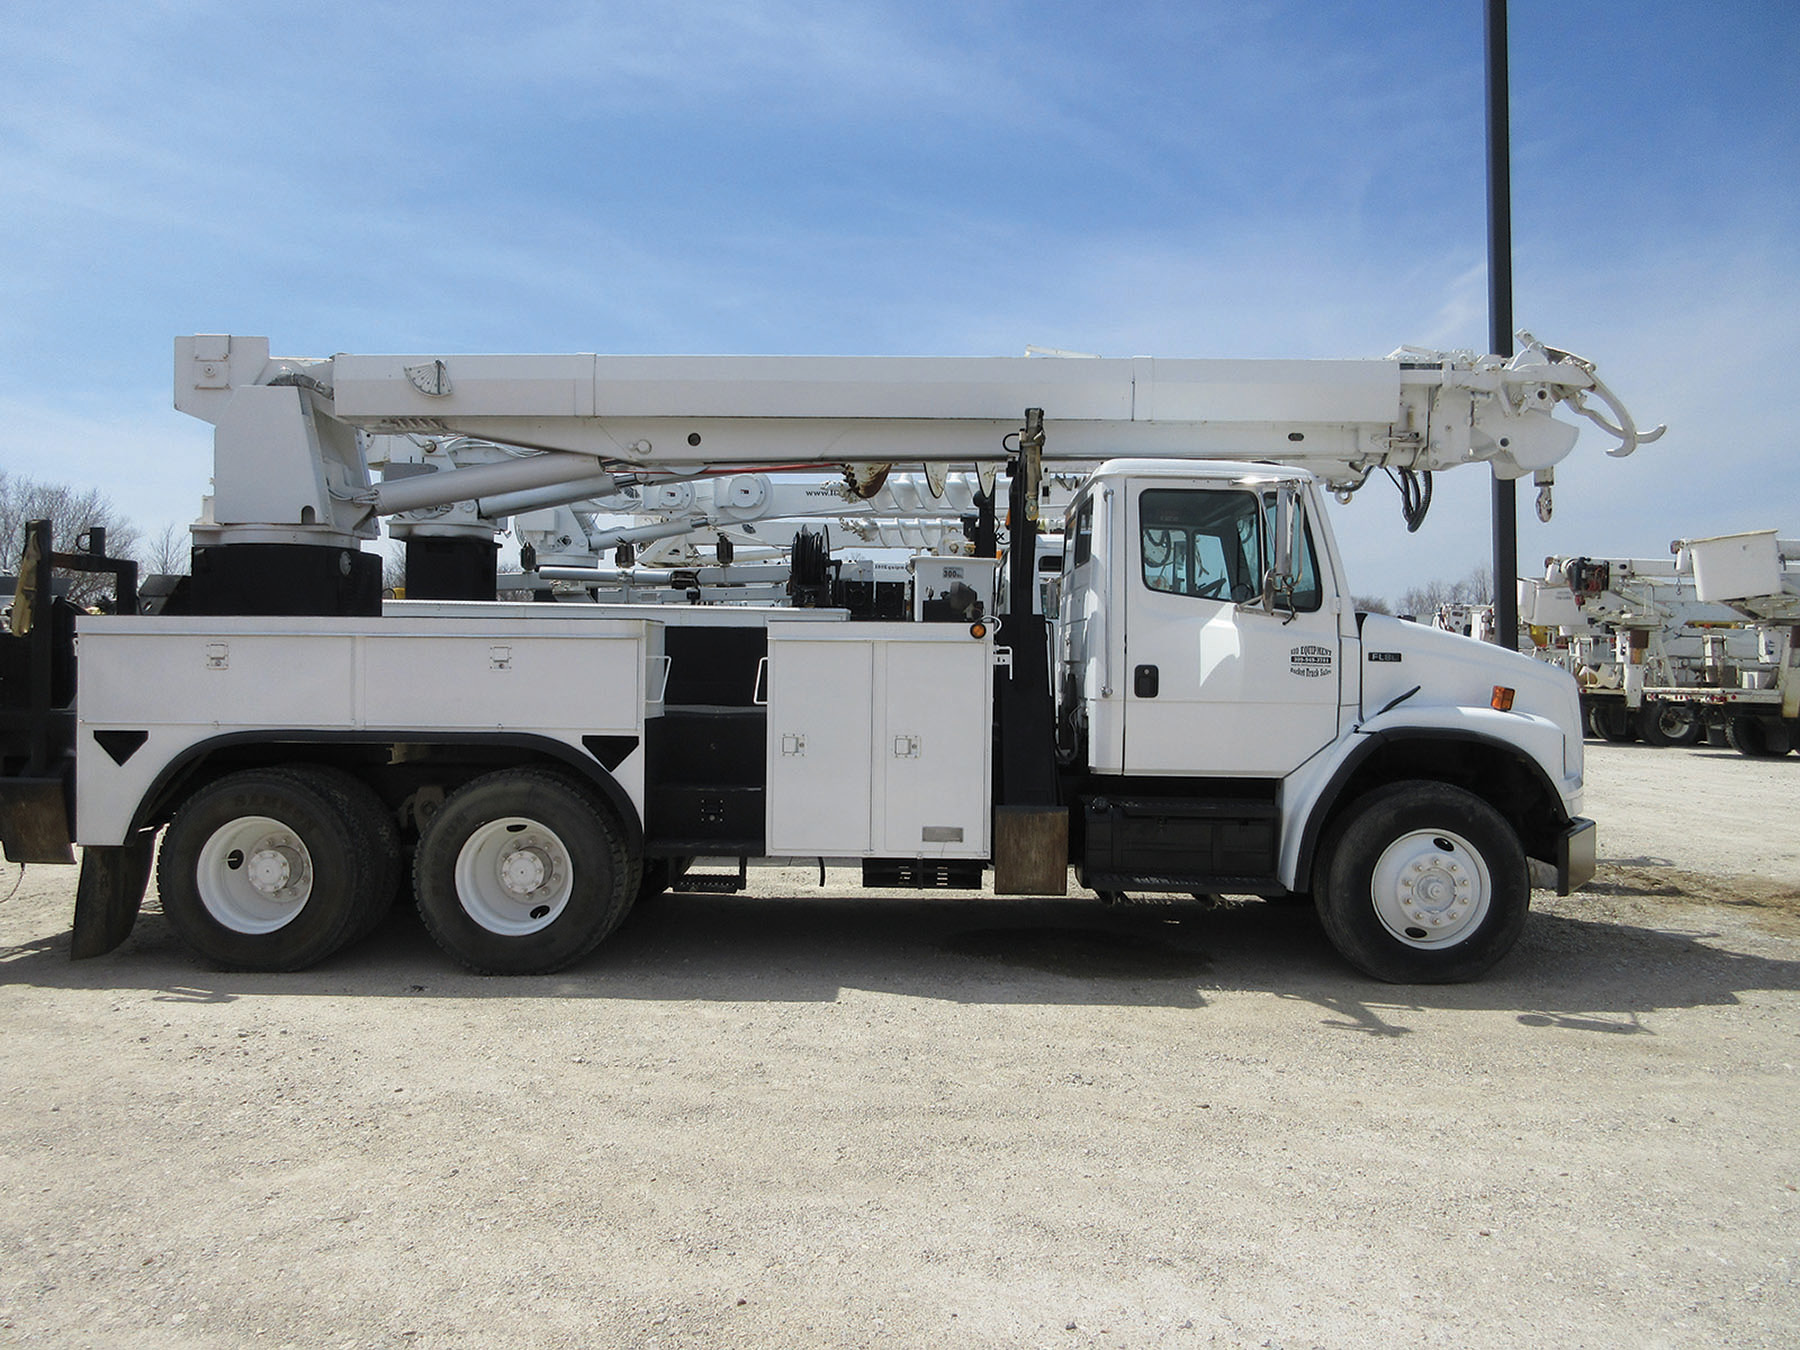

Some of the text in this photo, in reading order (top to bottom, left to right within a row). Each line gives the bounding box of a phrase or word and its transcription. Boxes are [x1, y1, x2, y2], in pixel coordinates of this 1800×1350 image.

[943, 570, 957, 578] 300
[1300, 645, 1332, 656] EQUIPMENT
[1306, 668, 1319, 677] Truck
